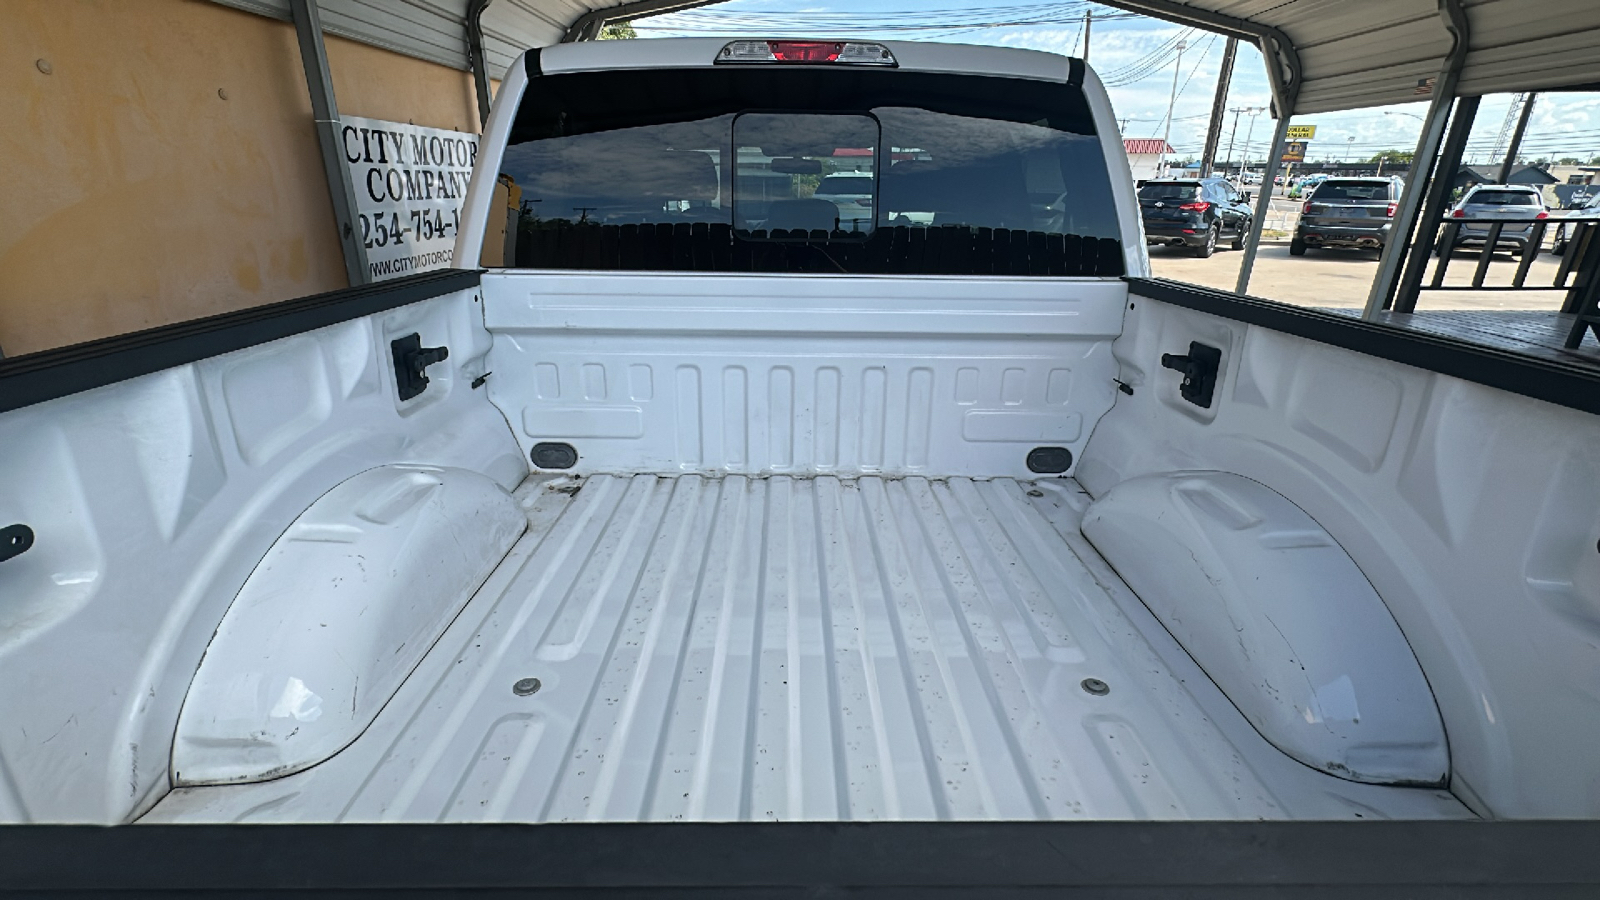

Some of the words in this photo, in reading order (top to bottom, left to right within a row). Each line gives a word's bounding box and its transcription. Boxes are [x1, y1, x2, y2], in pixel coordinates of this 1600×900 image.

[342, 125, 405, 164] CITY
[410, 133, 478, 168] MOTOR
[366, 167, 471, 203] COMPANY
